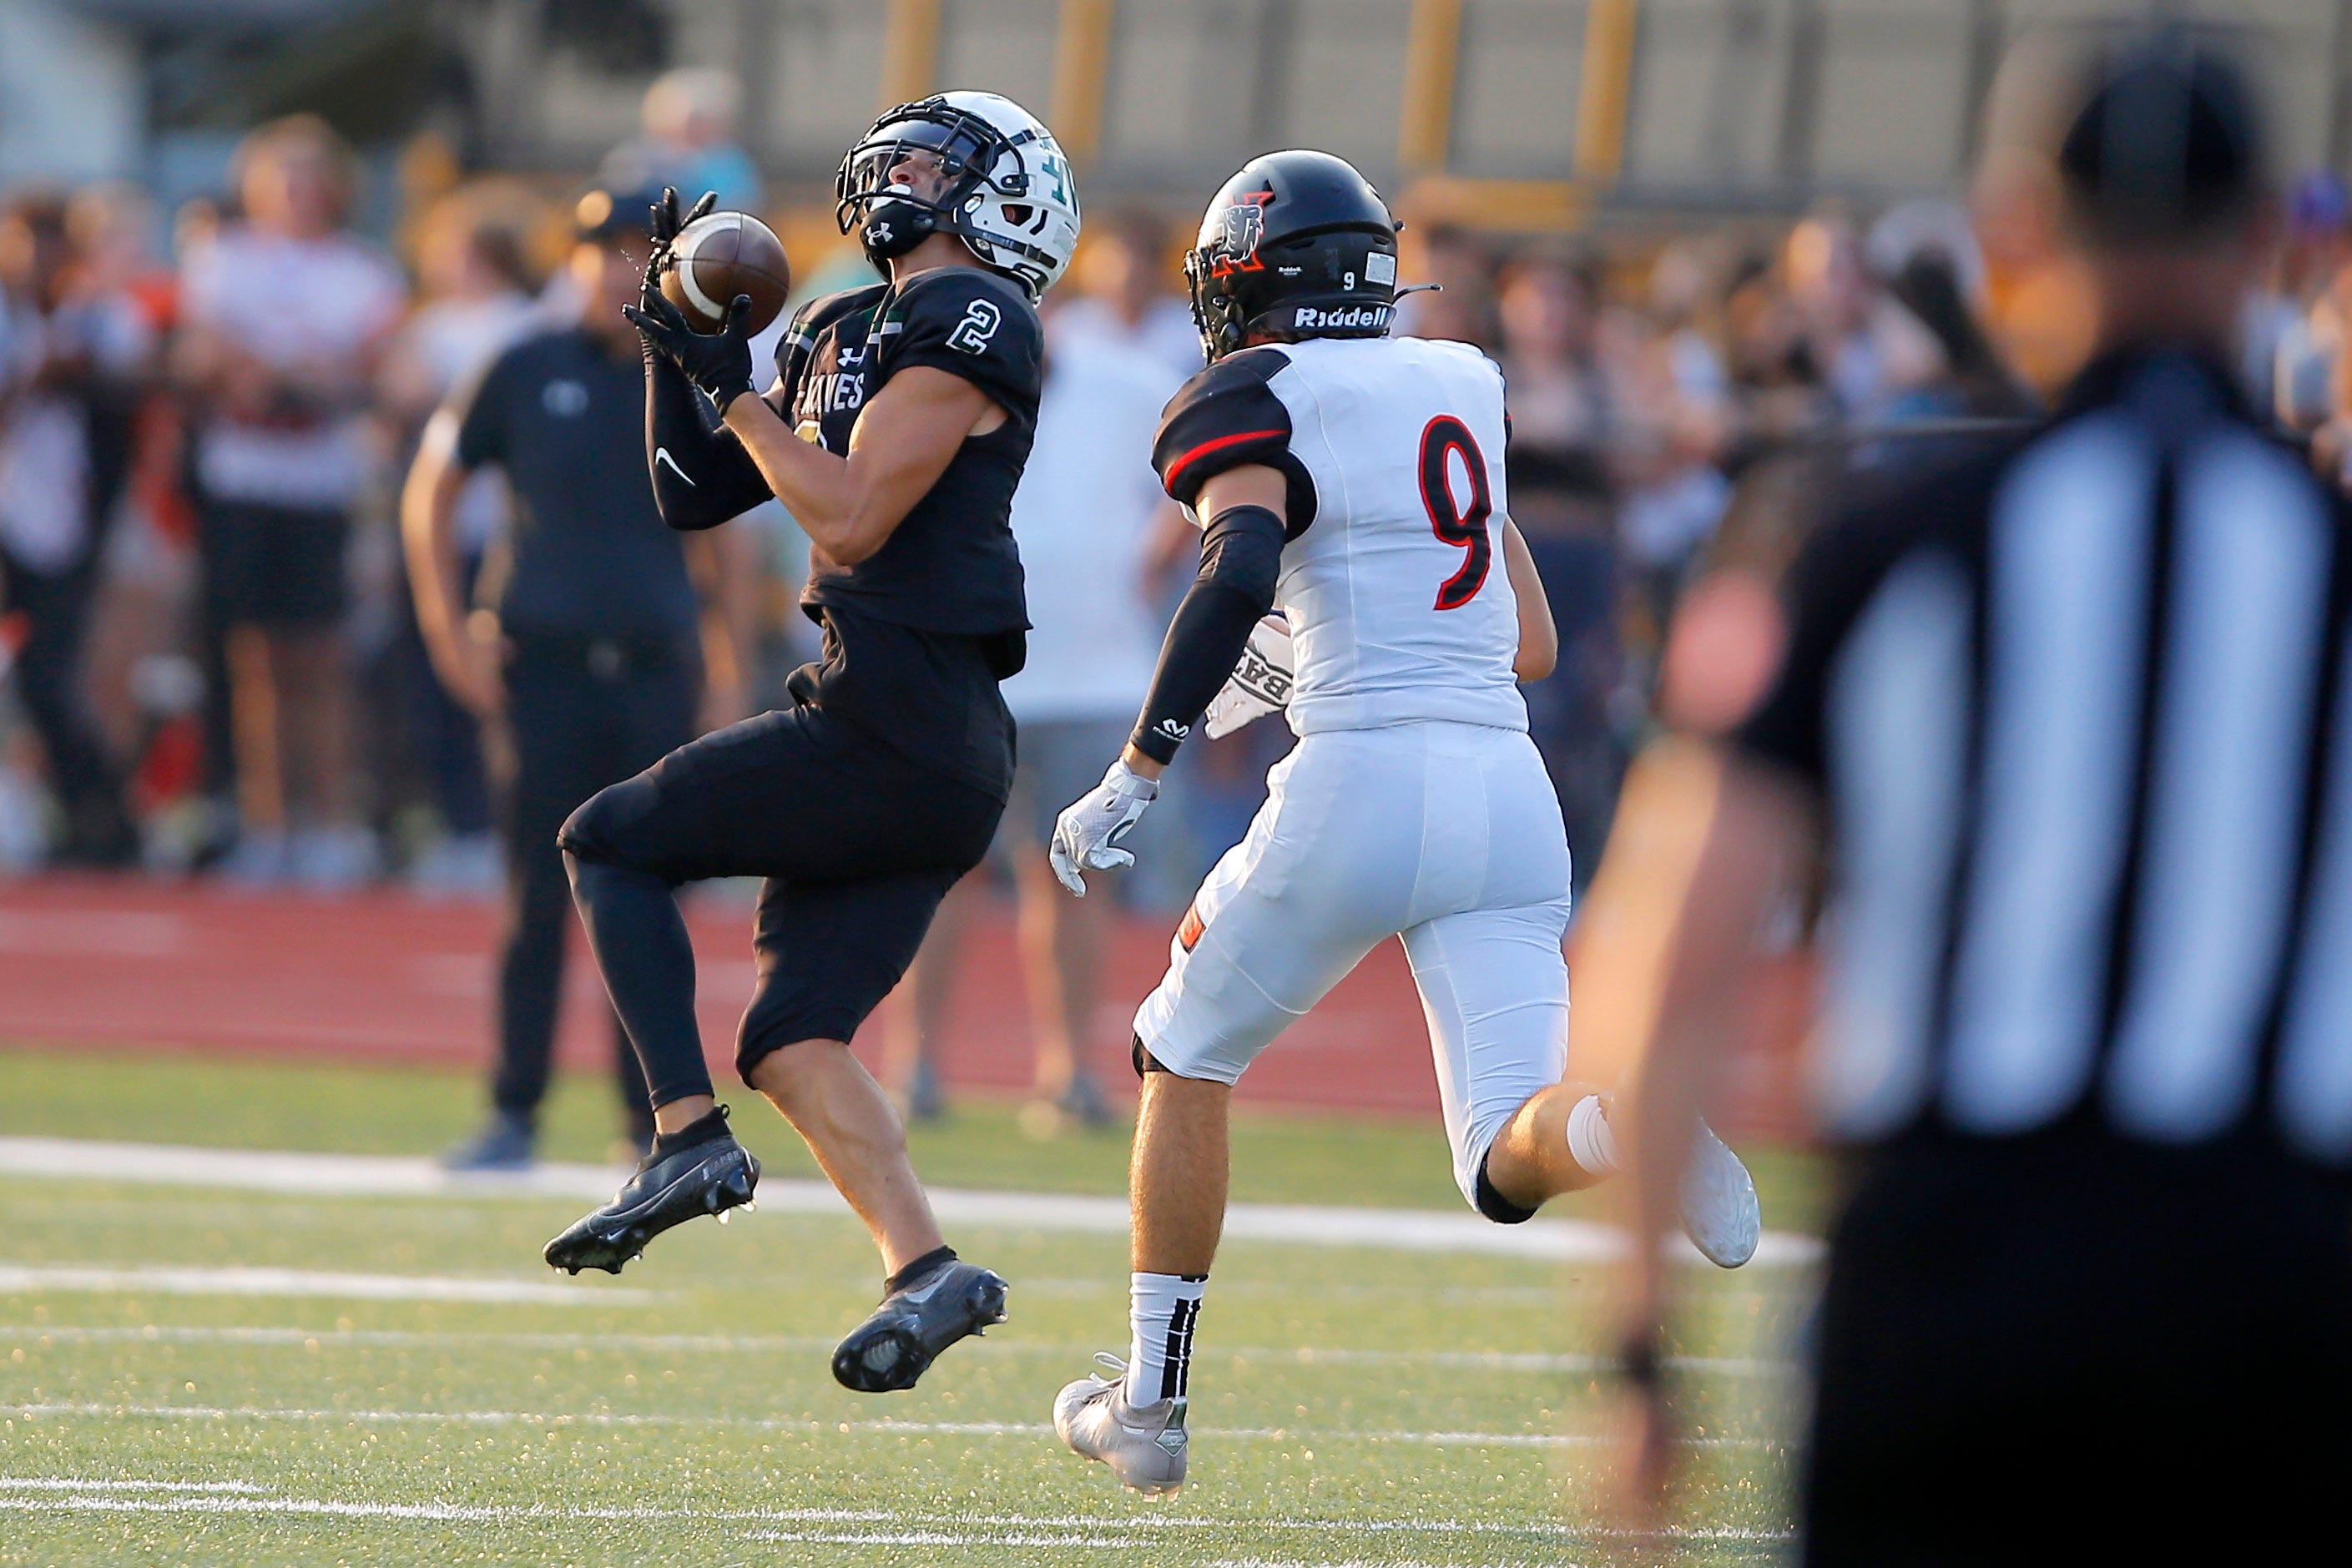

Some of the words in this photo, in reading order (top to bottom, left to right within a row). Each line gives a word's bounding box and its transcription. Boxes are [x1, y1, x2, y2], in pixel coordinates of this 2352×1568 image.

[1343, 271, 1355, 290] 9
[946, 298, 1002, 355] 2
[1294, 306, 1389, 328] Riddell
[1417, 414, 1492, 611] 9
